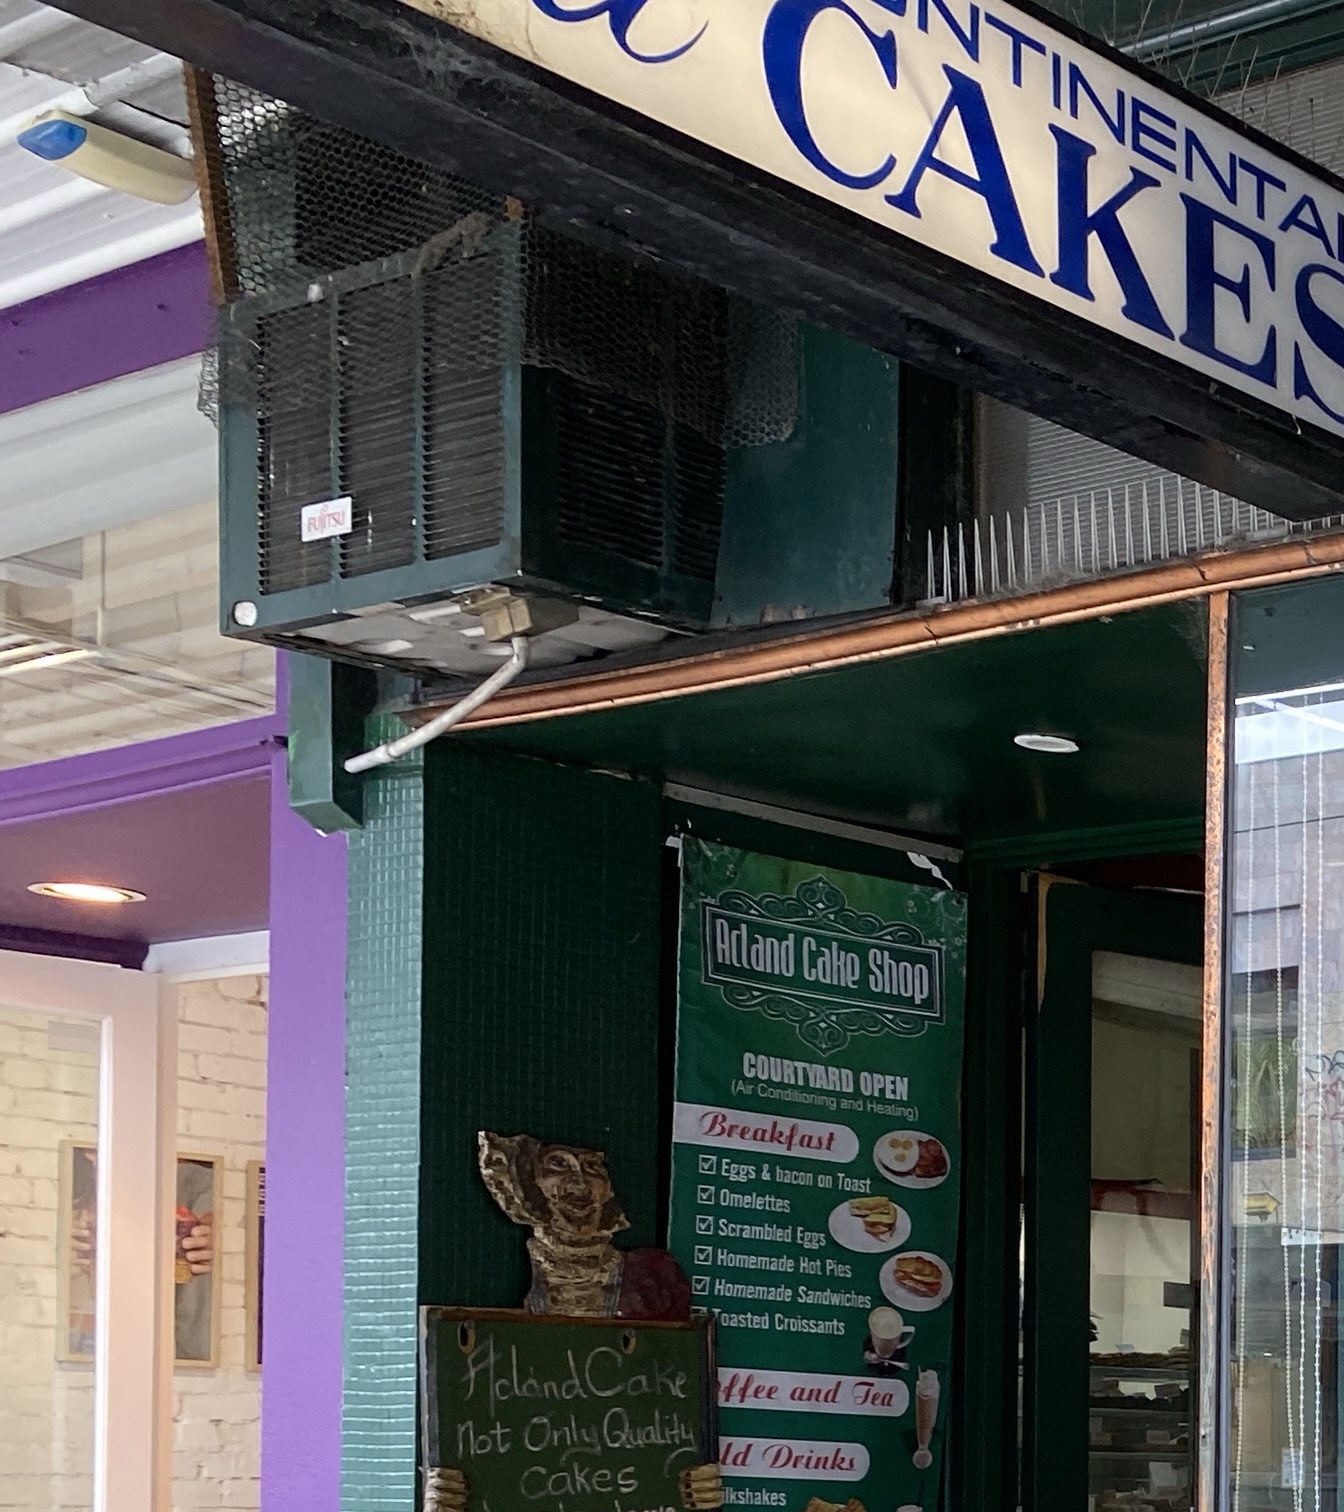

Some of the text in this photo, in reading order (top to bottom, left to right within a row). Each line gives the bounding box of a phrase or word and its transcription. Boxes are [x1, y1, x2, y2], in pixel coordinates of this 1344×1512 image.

[307, 508, 346, 534] FUJITSU
[715, 918, 929, 1004] Acland Cake Shop
[743, 1052, 909, 1100] COURTYARD OPEN
[731, 1079, 919, 1120] (Air Conditioning and Heating)
[700, 1111, 836, 1152] Breakfast
[721, 1158, 872, 1194] Eggs & bacon on Toast
[719, 1189, 791, 1213] Omelettes
[718, 1219, 827, 1249] Scrambled Eggs
[716, 1248, 852, 1279] Homemade Hot Pies
[714, 1278, 872, 1310] Homemade Sandwiches
[713, 1308, 846, 1335] Toasted Croissants
[585, 1346, 688, 1398] Cake
[790, 1380, 895, 1407] and Tea
[524, 1414, 602, 1462] Only
[603, 1407, 698, 1465] Quality
[762, 1442, 857, 1473] Drinks
[519, 1462, 640, 1499] Cakes
